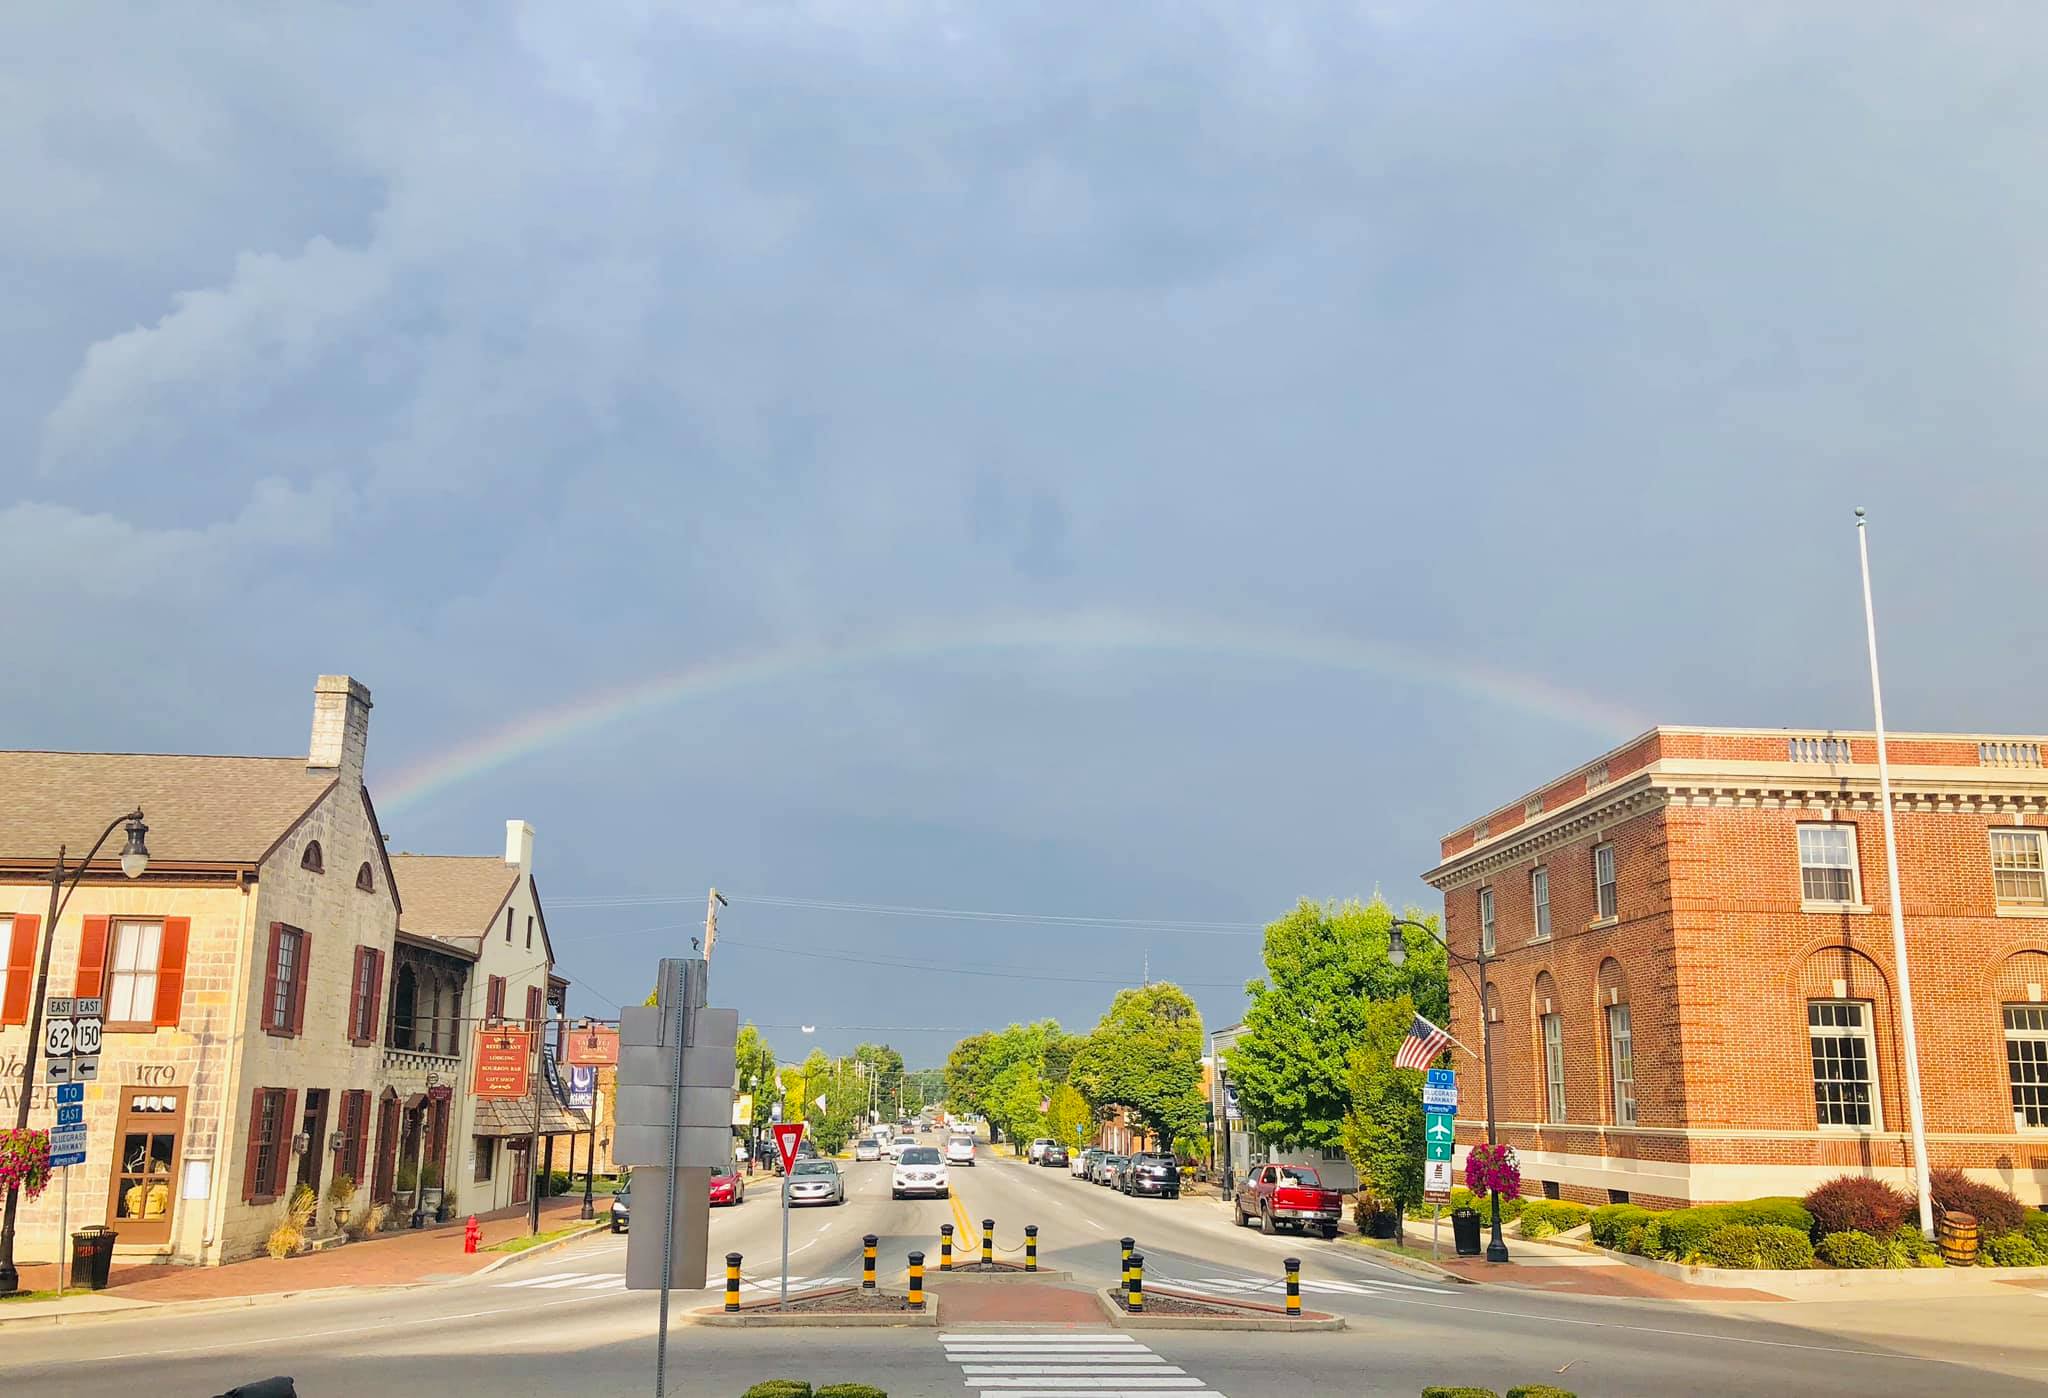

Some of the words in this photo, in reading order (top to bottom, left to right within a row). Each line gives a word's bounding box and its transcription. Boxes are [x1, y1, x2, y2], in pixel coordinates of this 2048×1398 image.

[51, 1001, 70, 1012] EAST
[80, 1000, 98, 1011] EAST
[50, 1028, 69, 1048] 62
[80, 1026, 98, 1046] 150
[136, 1064, 175, 1084] 1779
[1434, 1072, 1448, 1081] TO
[64, 1087, 77, 1099] TO
[60, 1108, 80, 1121] EAST
[53, 1142, 83, 1152] PARKWAY
